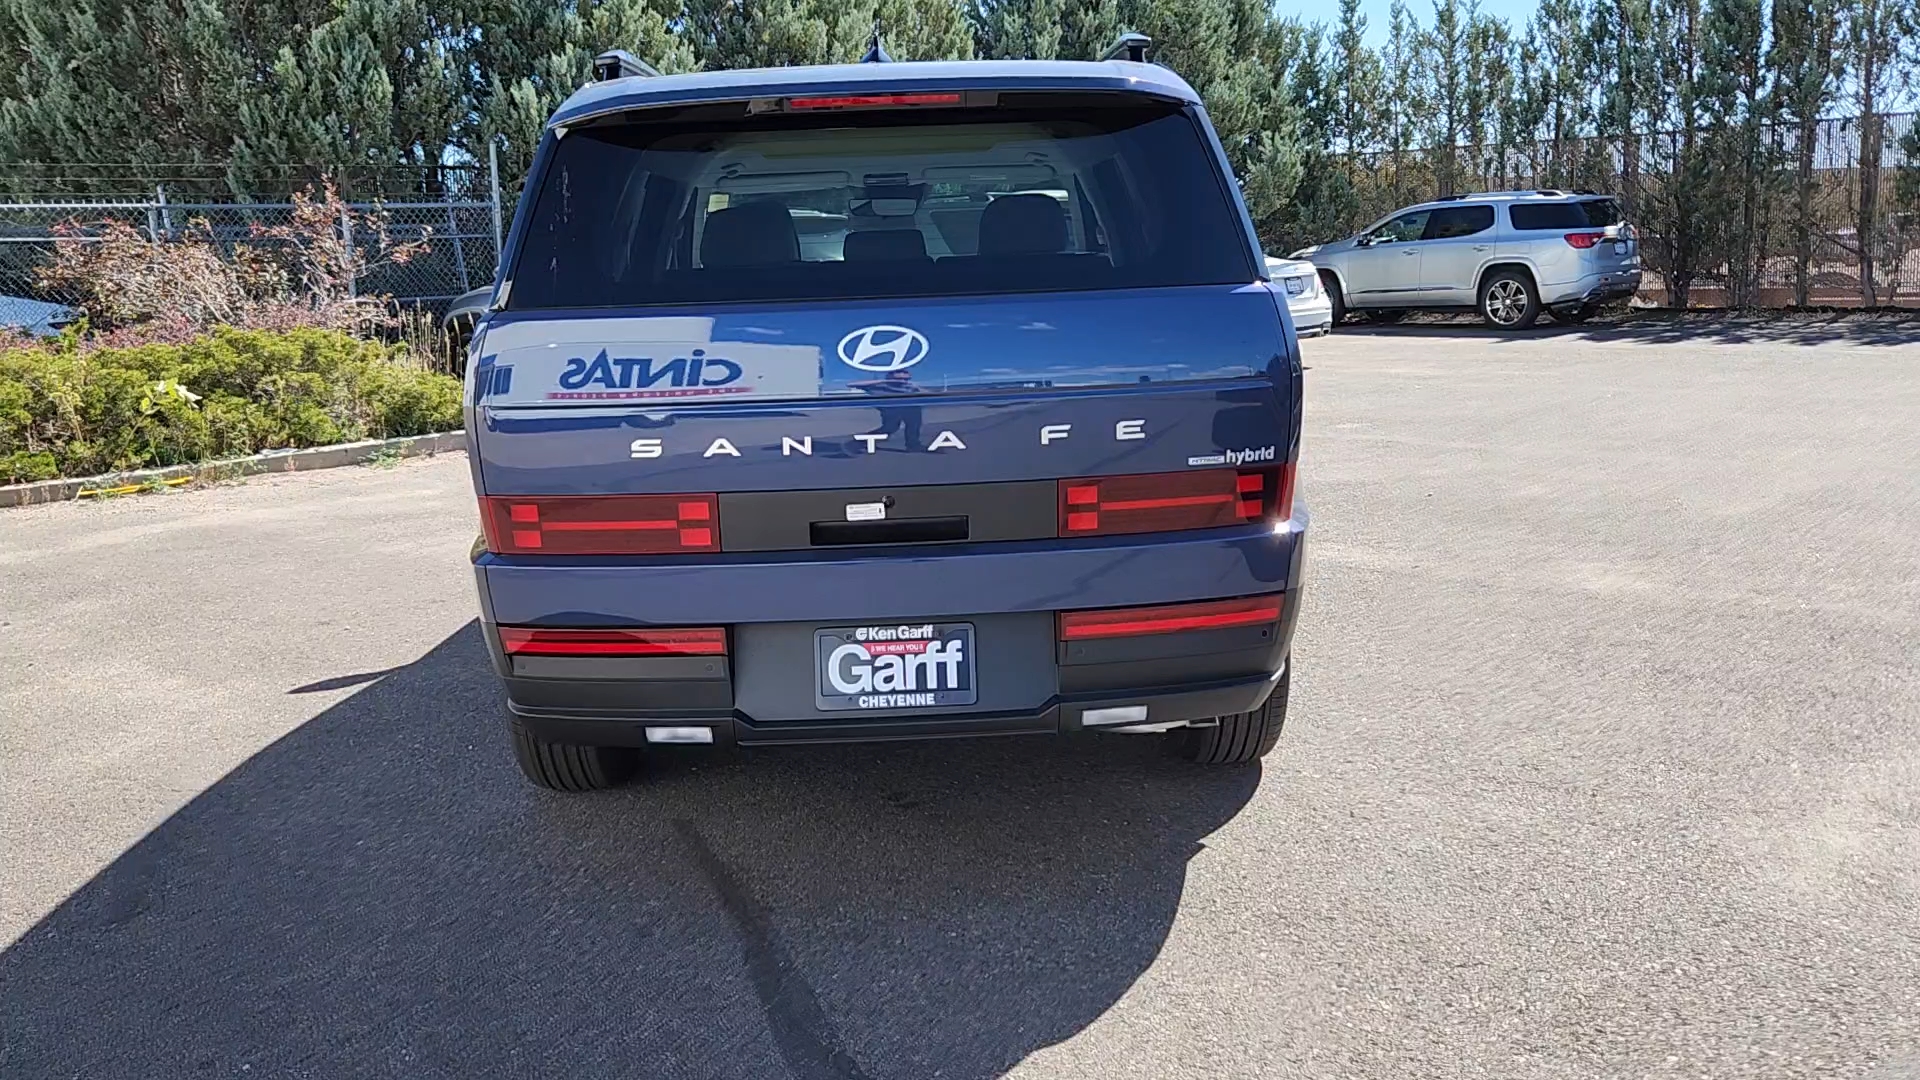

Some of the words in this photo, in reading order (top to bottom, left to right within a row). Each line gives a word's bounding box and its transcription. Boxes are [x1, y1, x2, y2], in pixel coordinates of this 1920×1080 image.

[630, 430, 967, 458] SANTA
[1040, 419, 1146, 445] FE
[1226, 446, 1275, 466] hybrid
[868, 626, 897, 640] Ken
[897, 624, 934, 639] Garff
[887, 644, 905, 652] HEAR
[906, 643, 918, 651] YOU
[828, 640, 963, 694] Garff
[859, 693, 935, 708] CHEYENNE
